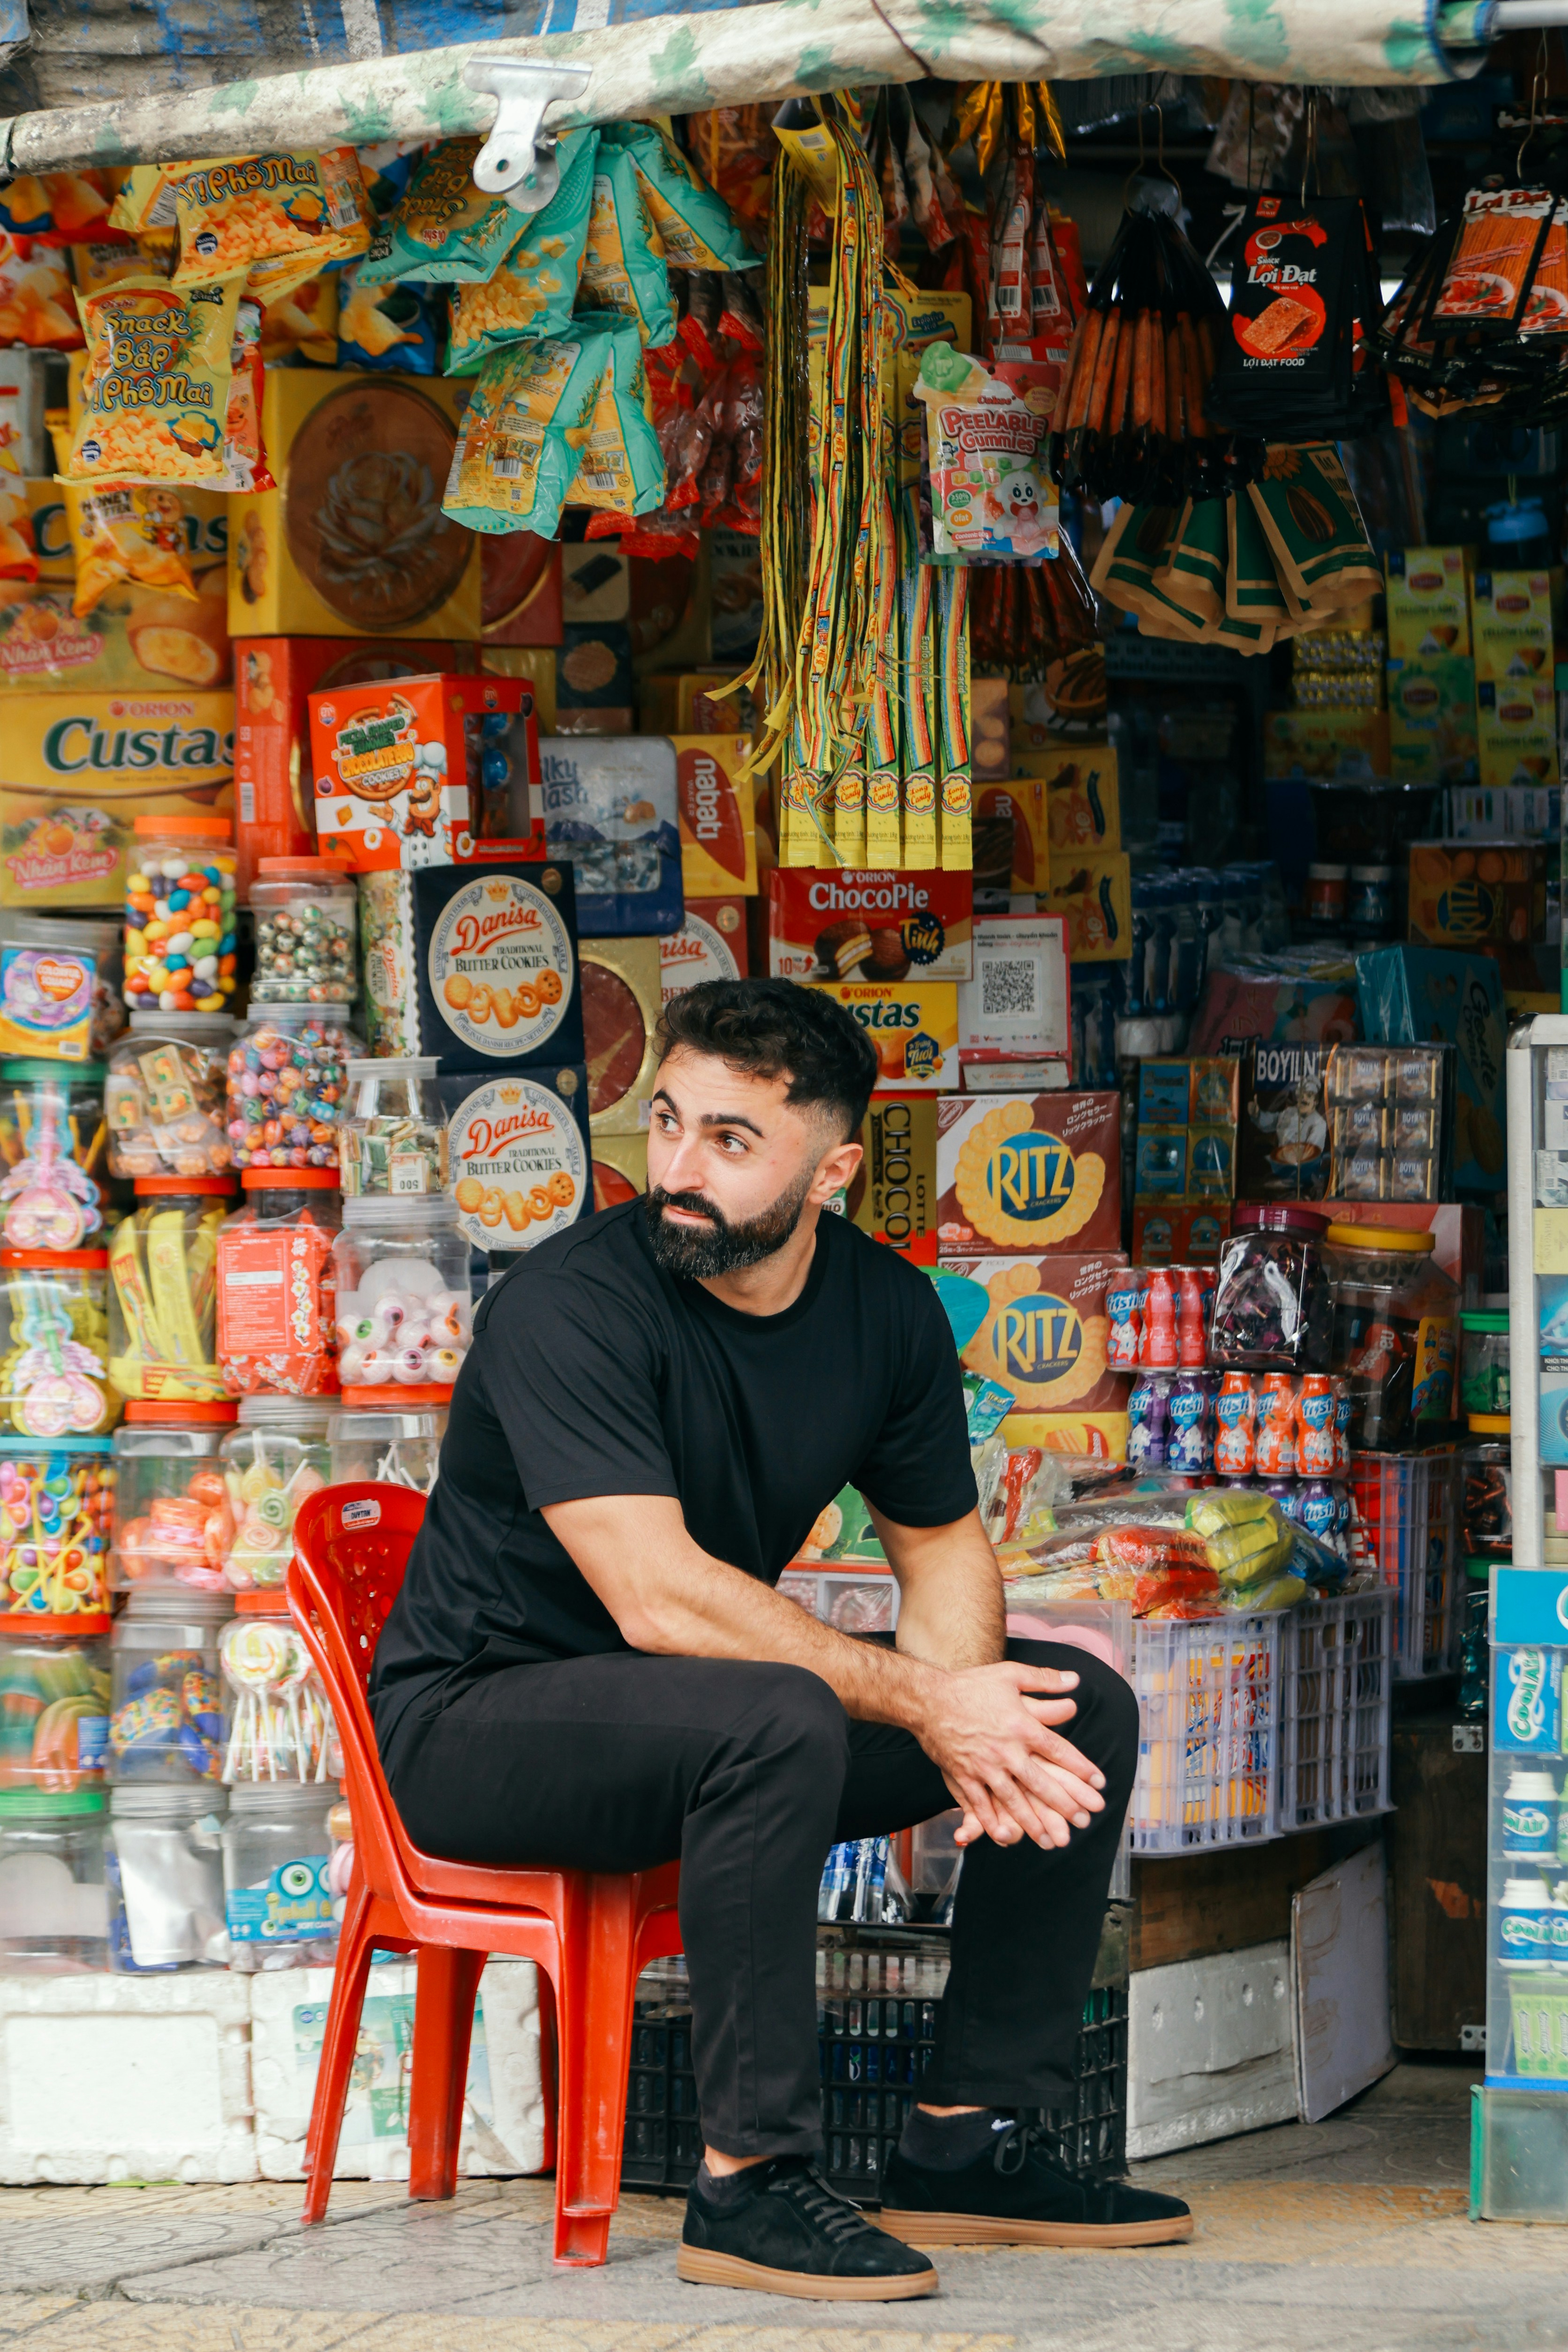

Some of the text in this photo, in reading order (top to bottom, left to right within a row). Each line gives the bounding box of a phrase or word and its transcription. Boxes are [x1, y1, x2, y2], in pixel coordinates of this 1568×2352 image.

[208, 166, 263, 201] Phô
[263, 157, 317, 188] Mai
[1247, 264, 1317, 287] Lợi Đạt
[100, 309, 191, 339] Snack
[113, 338, 172, 372] Bắp
[1243, 358, 1305, 369] LỢI ĐẠT FOOD
[102, 373, 212, 411] Phô Mai
[944, 410, 1046, 440] PEELABLE
[962, 431, 1035, 451] Gummies
[955, 531, 978, 540] Content:
[957, 636, 966, 694] Explosive acid
[129, 701, 194, 717] ORION
[362, 768, 400, 786] COOKIES
[840, 788, 861, 803] Candy
[873, 782, 891, 794] Long
[873, 789, 894, 803] Candy
[910, 782, 929, 795] Long
[947, 783, 965, 796] Long
[694, 758, 722, 840] nabati
[911, 790, 931, 805] Candy
[948, 790, 967, 806] Candy
[854, 872, 895, 883] ORION
[808, 882, 929, 911] ChocoPie
[450, 901, 542, 957] Danisa
[496, 944, 543, 955] TRADITIONAL
[659, 932, 708, 969] nisa
[455, 955, 550, 972] BUTTER COOKIES
[382, 946, 400, 1000] Danisa
[853, 987, 893, 997] ORION
[848, 999, 921, 1029] stas
[1067, 1103, 1107, 1125] ロングセラー
[1072, 1097, 1094, 1113] 世界の
[461, 1104, 555, 1160] Danisa
[509, 1147, 557, 1158] TRADITIONAL
[466, 1158, 563, 1176] BUTTER COOKIES
[992, 1145, 1072, 1212] RITZ
[916, 1175, 926, 1238] LOTTE
[1030, 1197, 1062, 1208] CRACKERS
[1079, 1260, 1103, 1276] 世界の
[997, 1307, 1078, 1373] RITZ
[1037, 1360, 1069, 1370] CRACKERS
